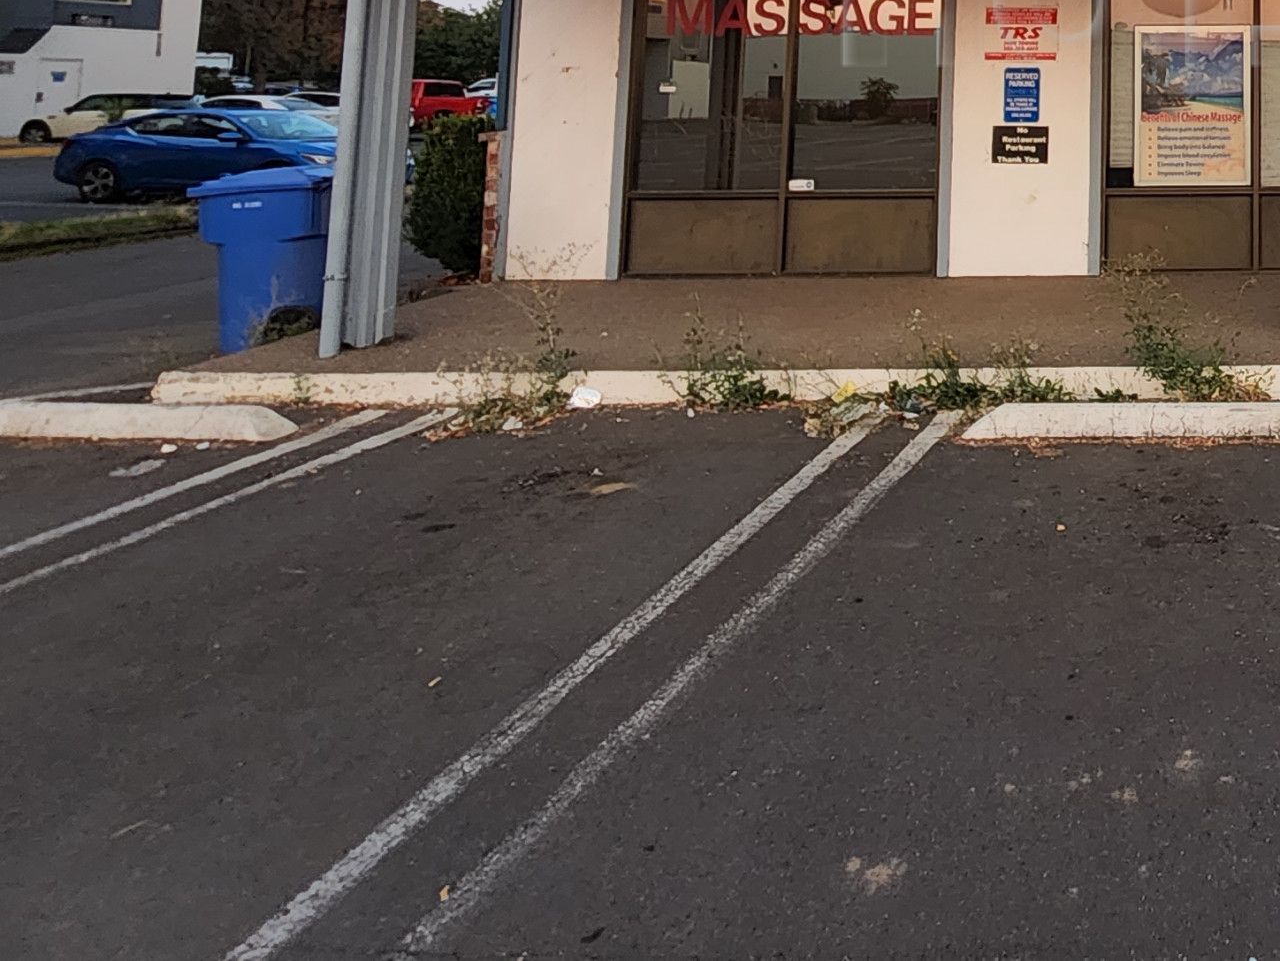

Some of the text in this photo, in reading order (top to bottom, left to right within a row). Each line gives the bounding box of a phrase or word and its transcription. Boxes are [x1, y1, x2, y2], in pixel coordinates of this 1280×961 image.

[1000, 26, 1043, 40] TRS
[1006, 72, 1039, 80] RESERVED
[1181, 112, 1209, 122] Chinese
[1211, 112, 1242, 124] Massage
[1005, 144, 1036, 153] Parking
